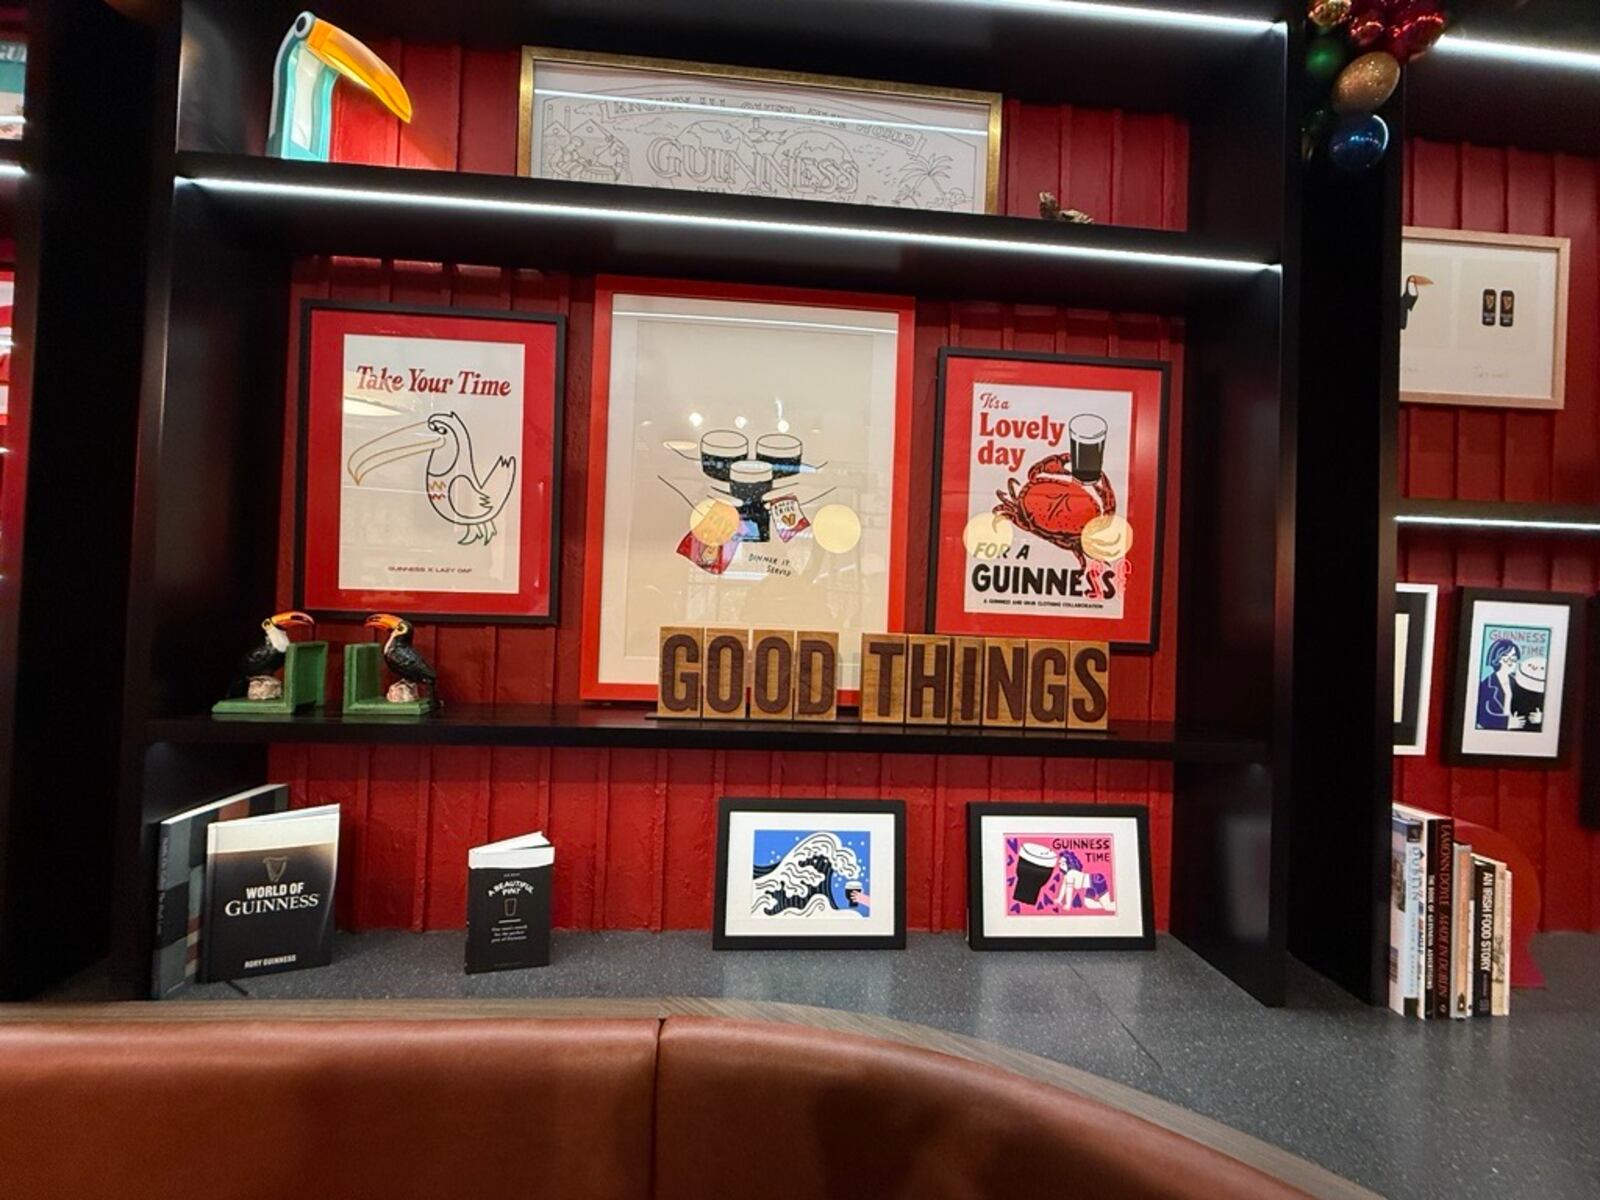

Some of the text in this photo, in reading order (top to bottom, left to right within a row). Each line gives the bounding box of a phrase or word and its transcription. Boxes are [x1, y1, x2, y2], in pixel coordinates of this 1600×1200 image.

[646, 135, 859, 194] GUINNESS
[356, 365, 512, 397] Take Your Time
[1001, 400, 1010, 410] a
[979, 412, 1066, 448] Lovely
[978, 440, 1026, 473] day
[973, 541, 1031, 560] FOR A
[971, 563, 1117, 600] GUINNESS
[1488, 628, 1547, 644] GUINNESS
[1519, 645, 1545, 657] TIME
[661, 634, 1108, 723] GOOD THINGS
[1052, 838, 1110, 850] GUINNESS
[1085, 852, 1110, 863] TIME
[1482, 871, 1494, 886] AN
[246, 882, 305, 900] WORLD OF
[1481, 887, 1493, 912] IRISH
[224, 893, 320, 917] GUINNESS
[1481, 913, 1493, 940] FOOD
[263, 954, 297, 967] GUINNESS
[1480, 940, 1492, 972] STORY
